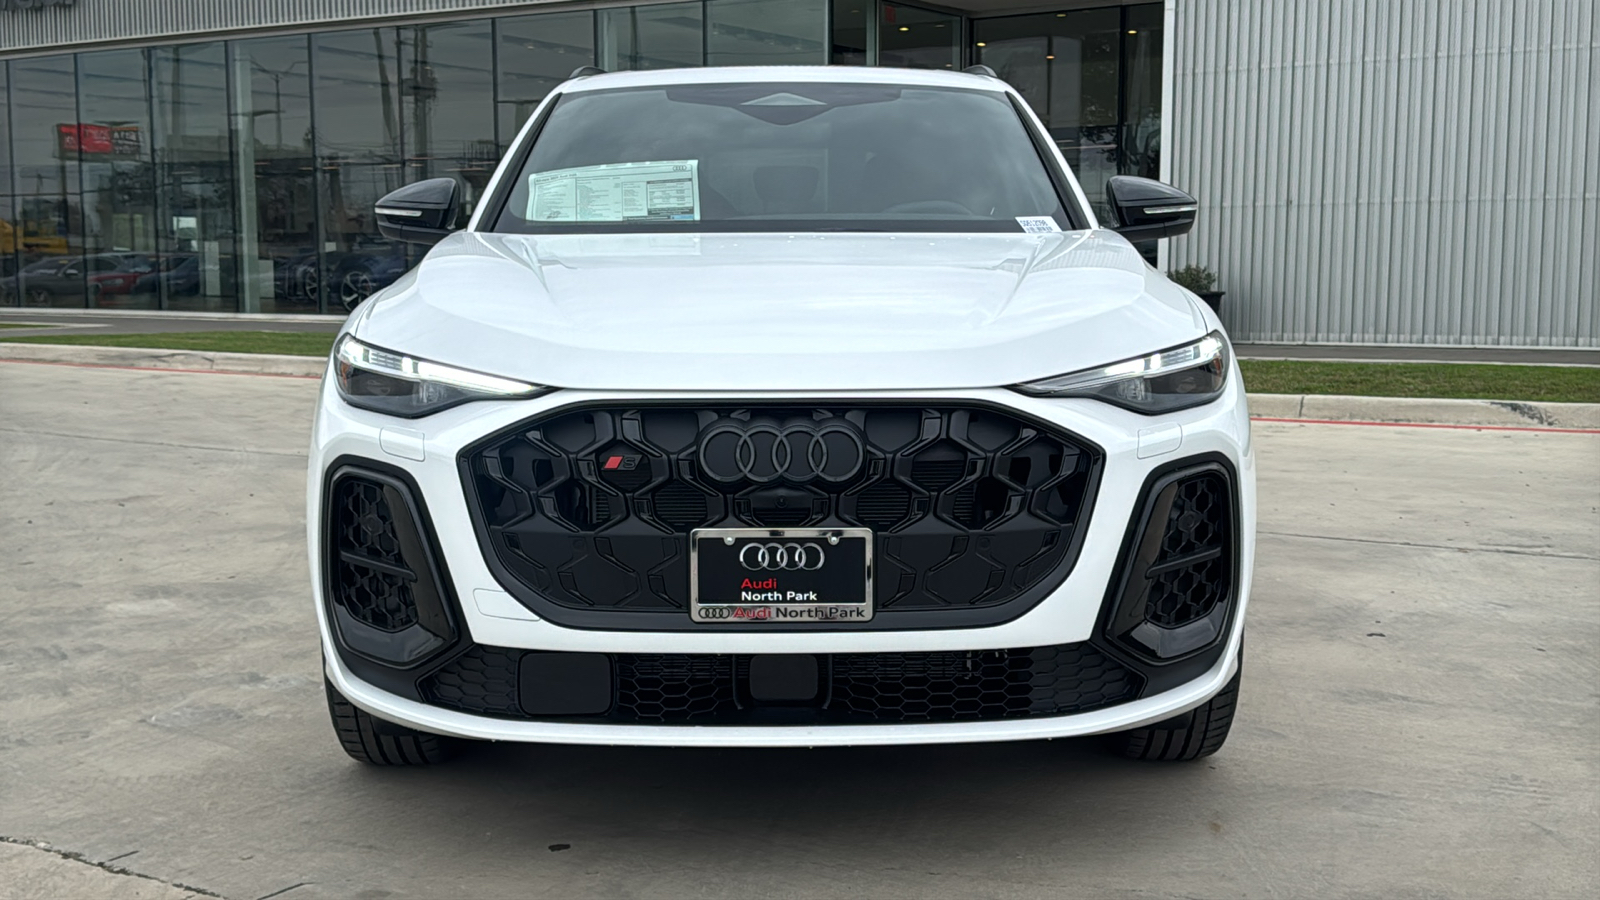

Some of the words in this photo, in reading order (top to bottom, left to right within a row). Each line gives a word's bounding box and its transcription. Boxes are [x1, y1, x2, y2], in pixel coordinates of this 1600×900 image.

[624, 457, 635, 468] S
[741, 578, 777, 589] Audi
[741, 591, 782, 601] North
[786, 591, 817, 601] Park
[733, 607, 772, 619] Audi
[776, 607, 824, 618] North
[828, 607, 866, 618] Park
